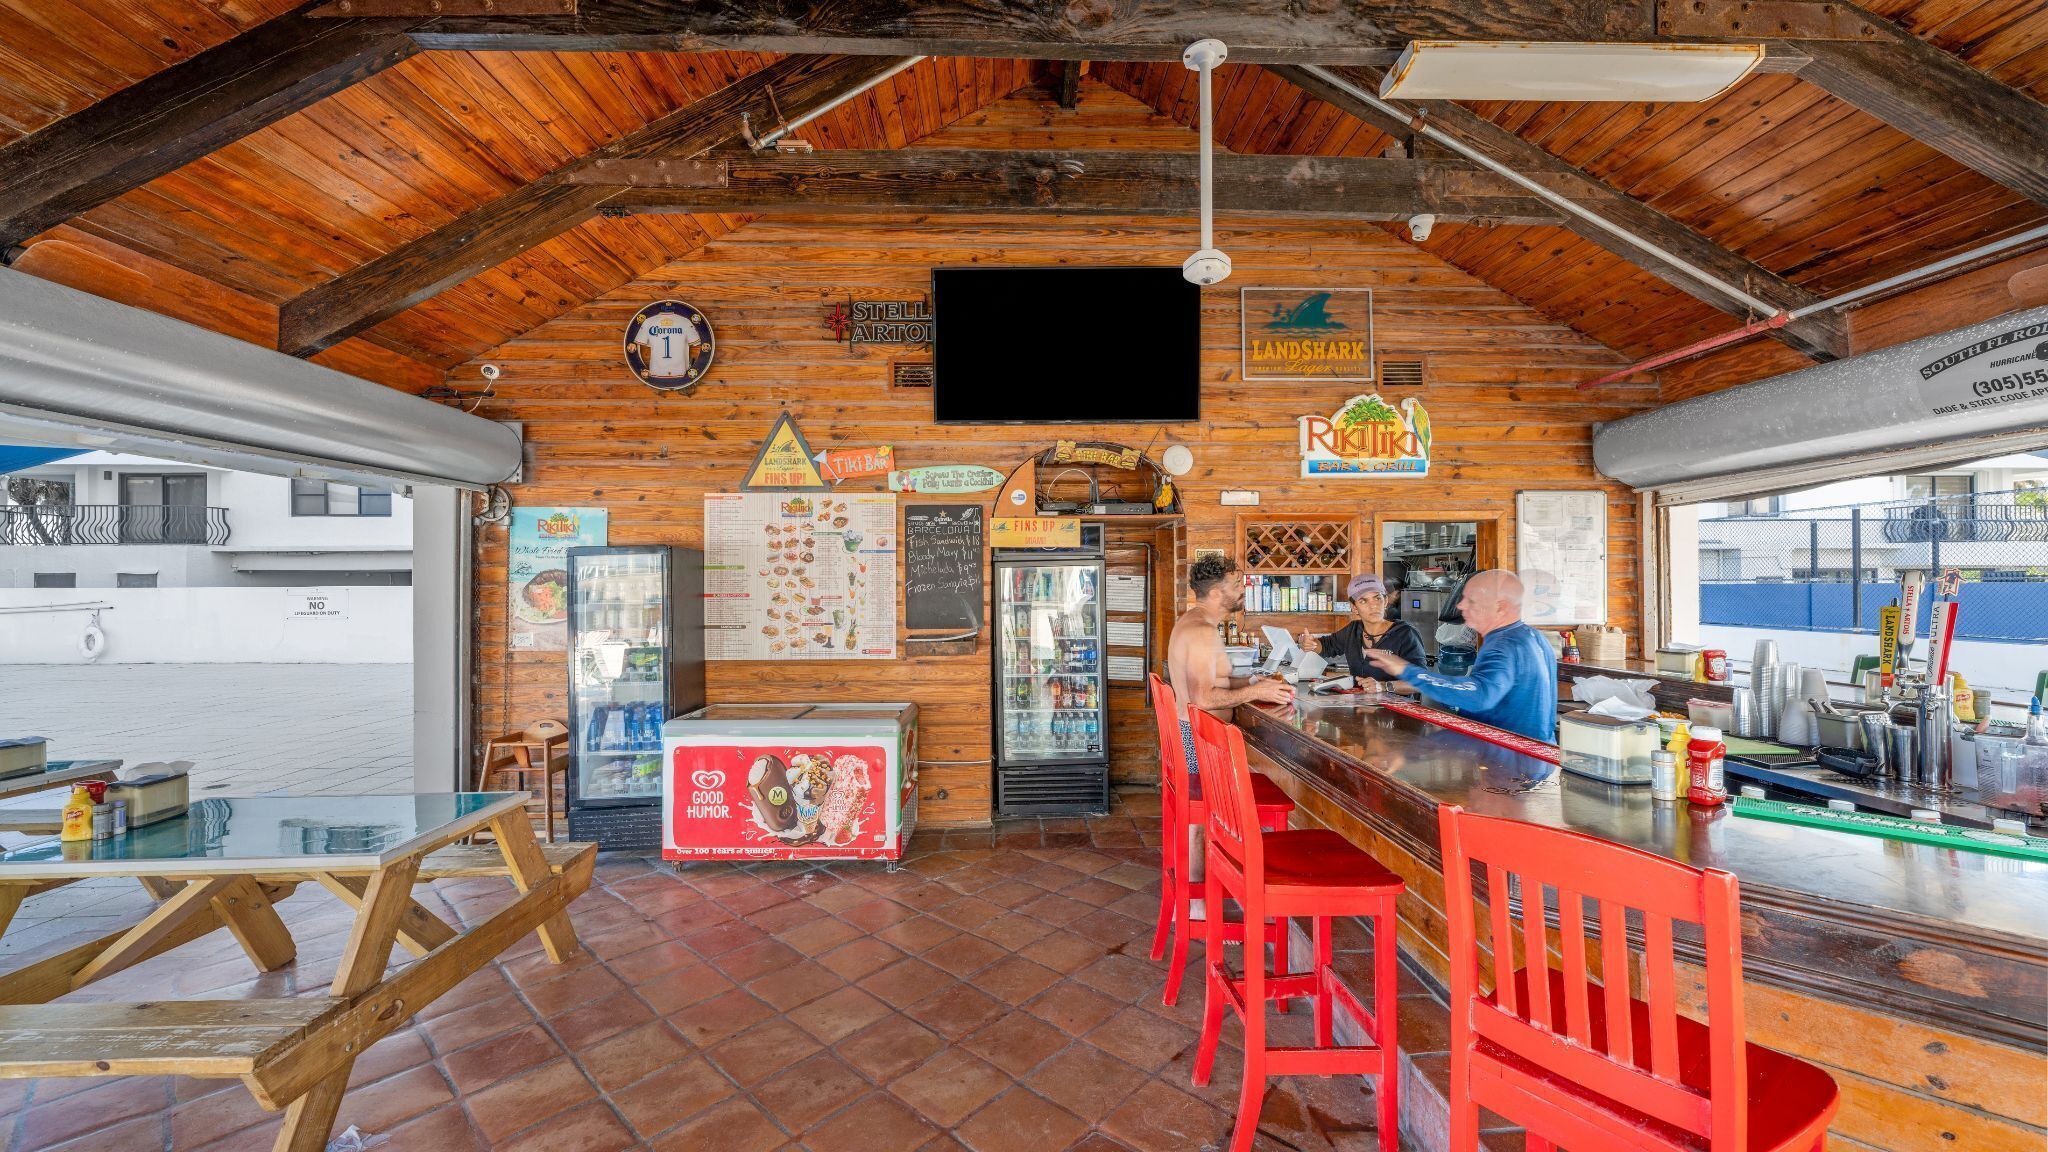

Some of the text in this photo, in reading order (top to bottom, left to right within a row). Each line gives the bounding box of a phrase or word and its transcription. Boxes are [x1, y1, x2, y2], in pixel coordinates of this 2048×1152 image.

[853, 301, 932, 321] STELL
[648, 325, 683, 337] Corona
[661, 335, 673, 359] 1
[1251, 340, 1365, 360] LANDSHARK
[1922, 343, 1981, 379] SOUTH
[1987, 337, 2008, 350] FL
[1989, 351, 2037, 369] HURRICANE
[1284, 359, 1331, 377] Lager
[1972, 368, 2048, 398] (305)55
[1932, 404, 1958, 415] DADE
[1959, 402, 1969, 410] &
[1969, 397, 2000, 409] STATE
[2000, 391, 2031, 403] CODE
[764, 457, 807, 466] LANDSHARK
[864, 453, 890, 472] BAR
[1317, 460, 1352, 472] BAR
[1373, 461, 1418, 472] GRILL
[764, 472, 807, 484] FINS UP!
[951, 470, 965, 480] The
[922, 479, 940, 490] Polly
[907, 526, 970, 535] BARCELONA
[1014, 520, 1055, 532] FINS UP
[906, 535, 929, 549] Fish
[908, 547, 936, 565] Bloody
[936, 546, 959, 561] Mary
[905, 579, 936, 597] Frozen
[1905, 585, 1914, 607] STELLA
[309, 601, 325, 610] NO
[1902, 612, 1911, 635] ARTOIS
[1931, 606, 1941, 639] ULTRA
[1882, 615, 1896, 665] LANDSHARK
[692, 790, 724, 804] GOOD
[772, 789, 784, 800] M
